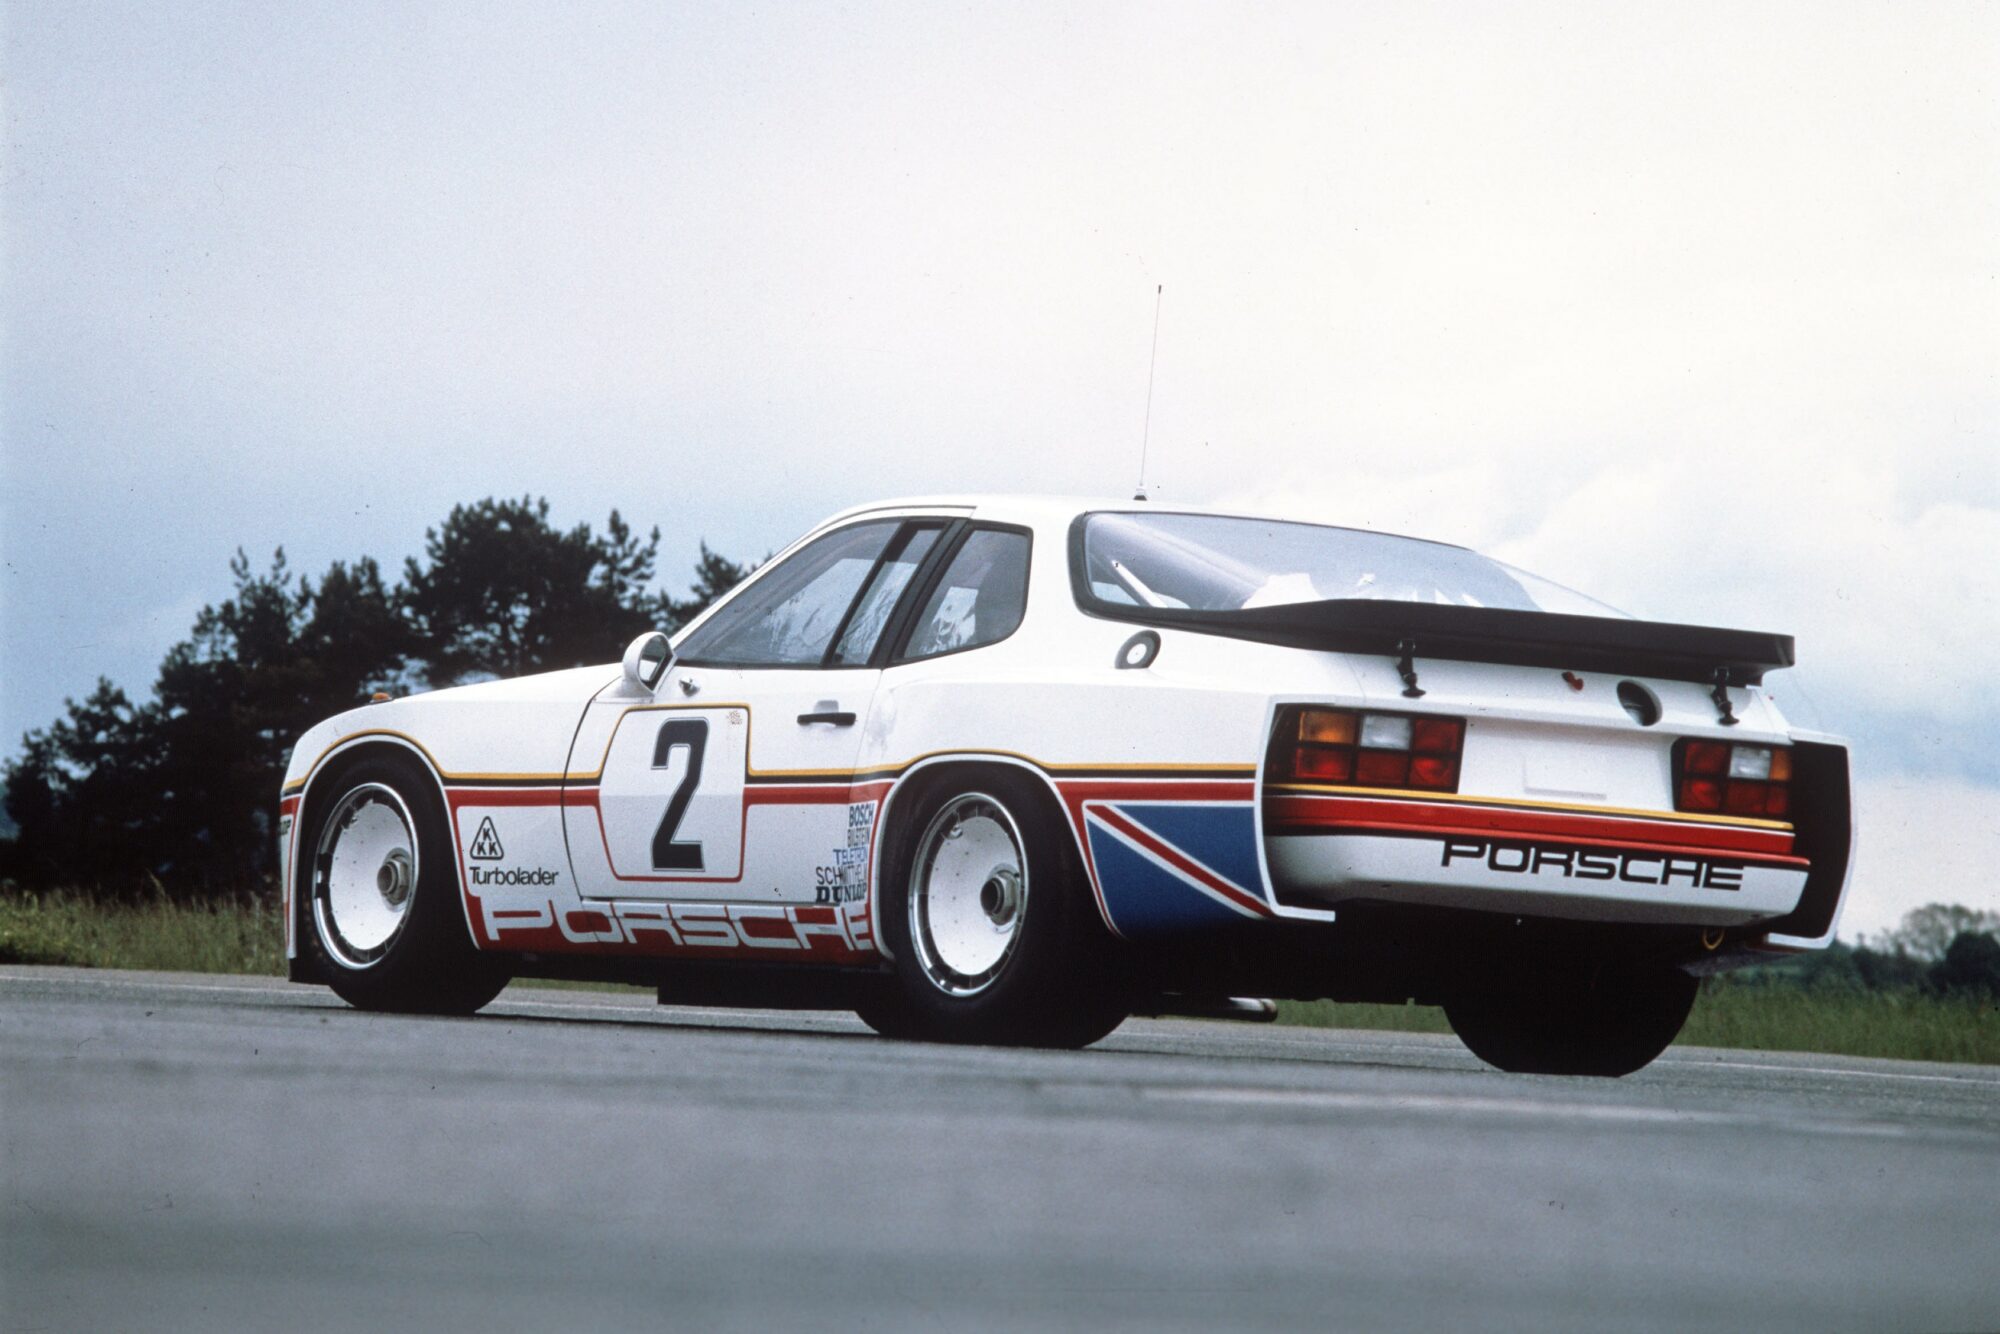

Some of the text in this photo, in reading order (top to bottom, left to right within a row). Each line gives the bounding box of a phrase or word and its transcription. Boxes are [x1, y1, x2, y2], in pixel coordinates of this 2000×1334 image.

[650, 717, 709, 872] 2
[849, 802, 874, 827] BOSCH
[469, 866, 559, 886] Turbolader
[1441, 840, 1744, 891] PORSCHE
[816, 883, 867, 903] DUNLOP
[480, 898, 873, 952] PORSCHE
